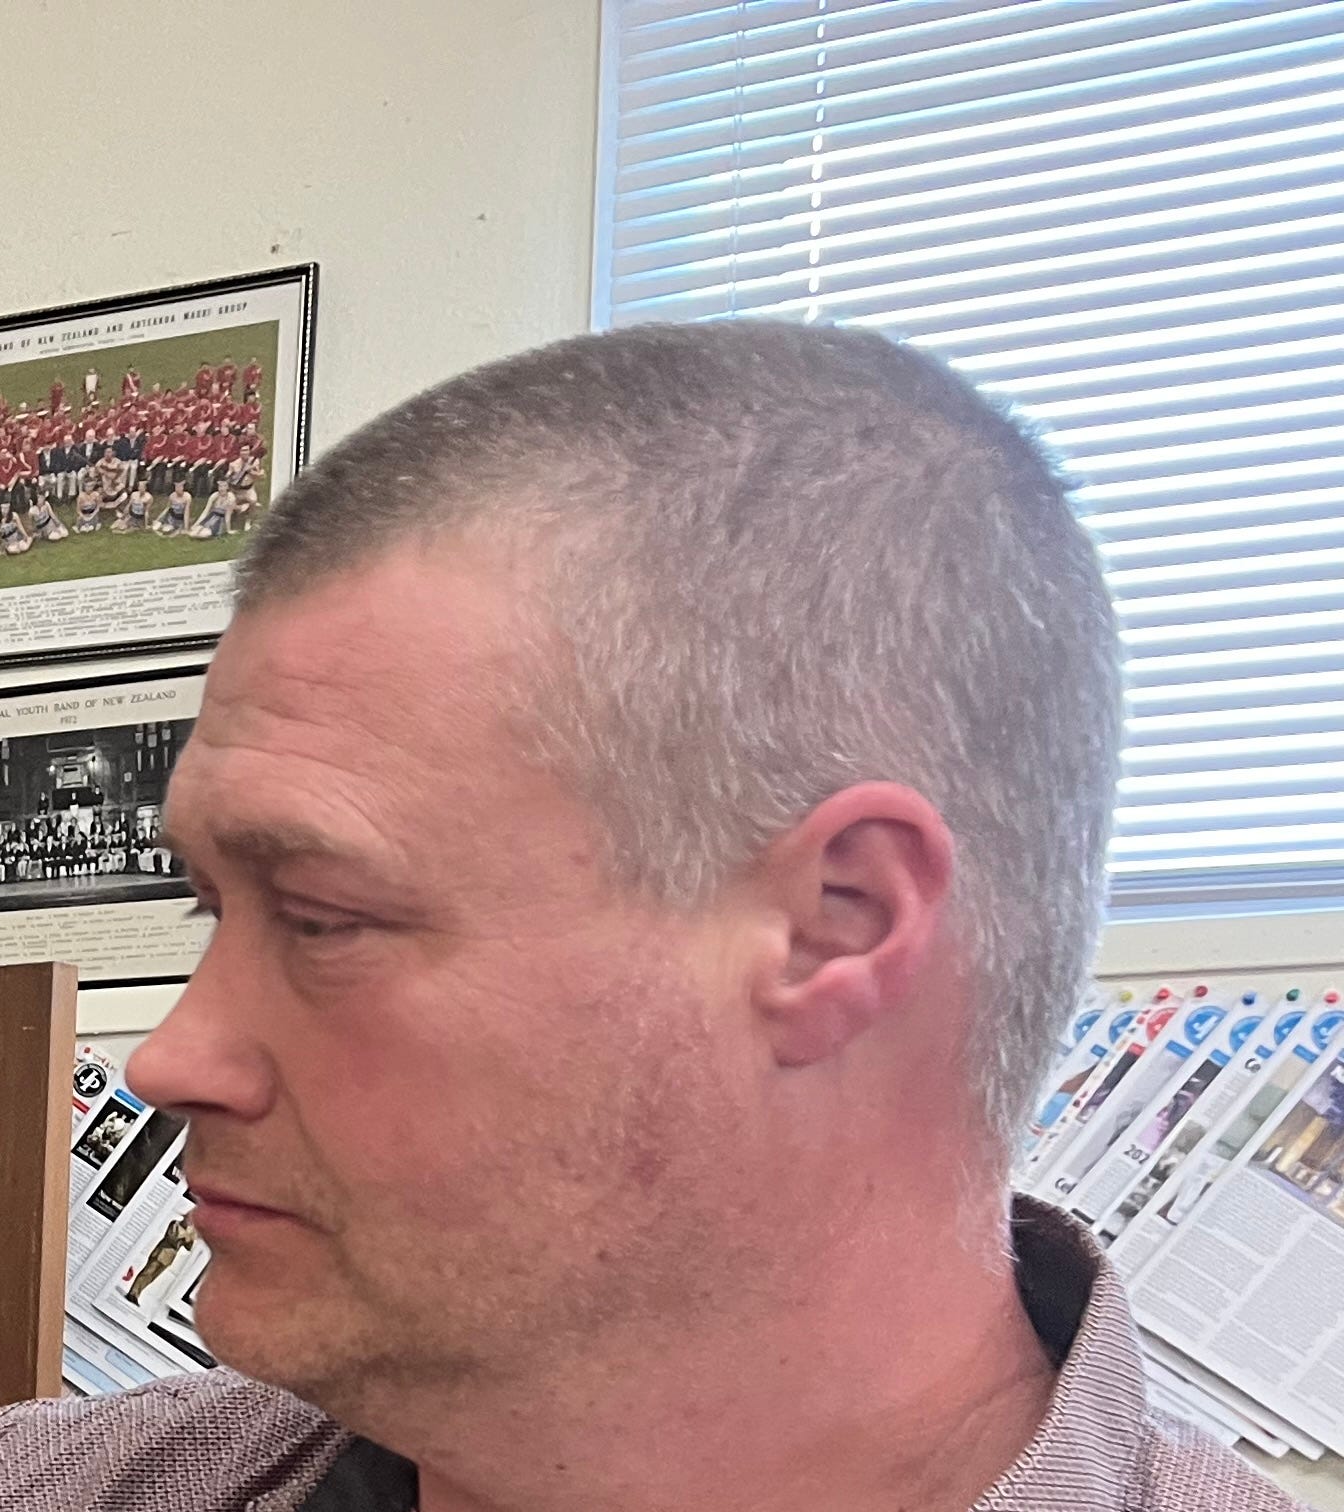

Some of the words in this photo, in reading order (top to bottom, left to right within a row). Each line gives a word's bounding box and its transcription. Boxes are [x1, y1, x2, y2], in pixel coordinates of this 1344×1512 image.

[16, 705, 48, 716] YOUTH
[53, 701, 80, 712] BAND
[84, 699, 99, 708] OF
[103, 695, 125, 706] NEW
[130, 690, 176, 704] ZEALAND
